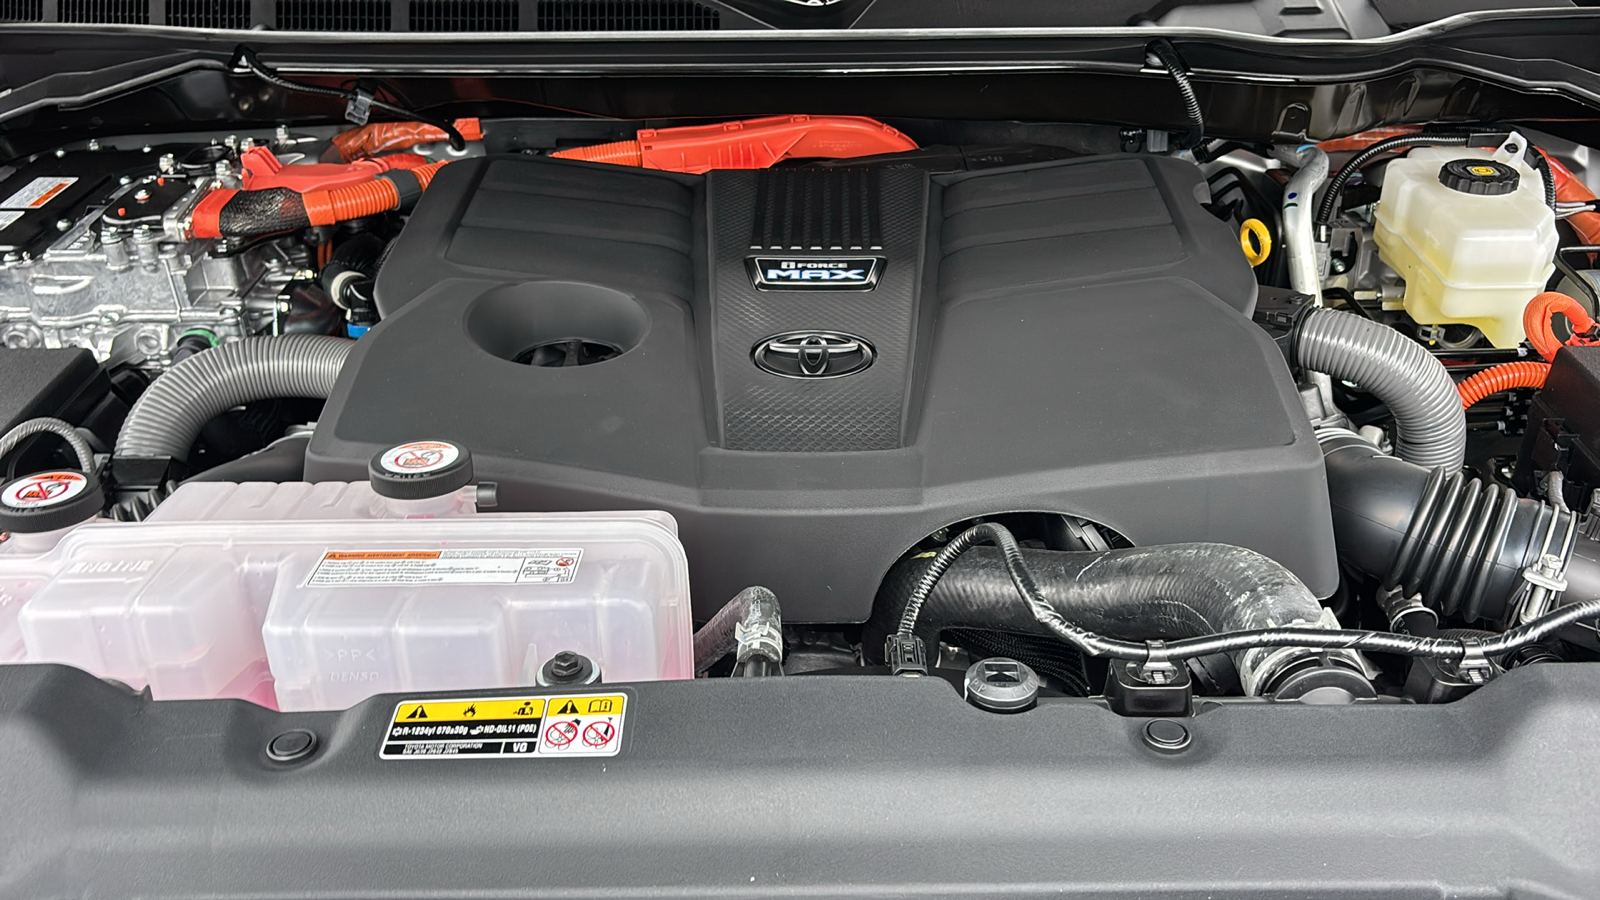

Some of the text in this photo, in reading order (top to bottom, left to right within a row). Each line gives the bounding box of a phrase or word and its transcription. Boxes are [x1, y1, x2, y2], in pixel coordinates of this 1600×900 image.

[766, 269, 865, 280] MAX
[68, 560, 154, 574] ENGINE
[330, 671, 379, 682] DENSO
[517, 723, 537, 734] (POE)
[445, 742, 483, 750] CORPORATION
